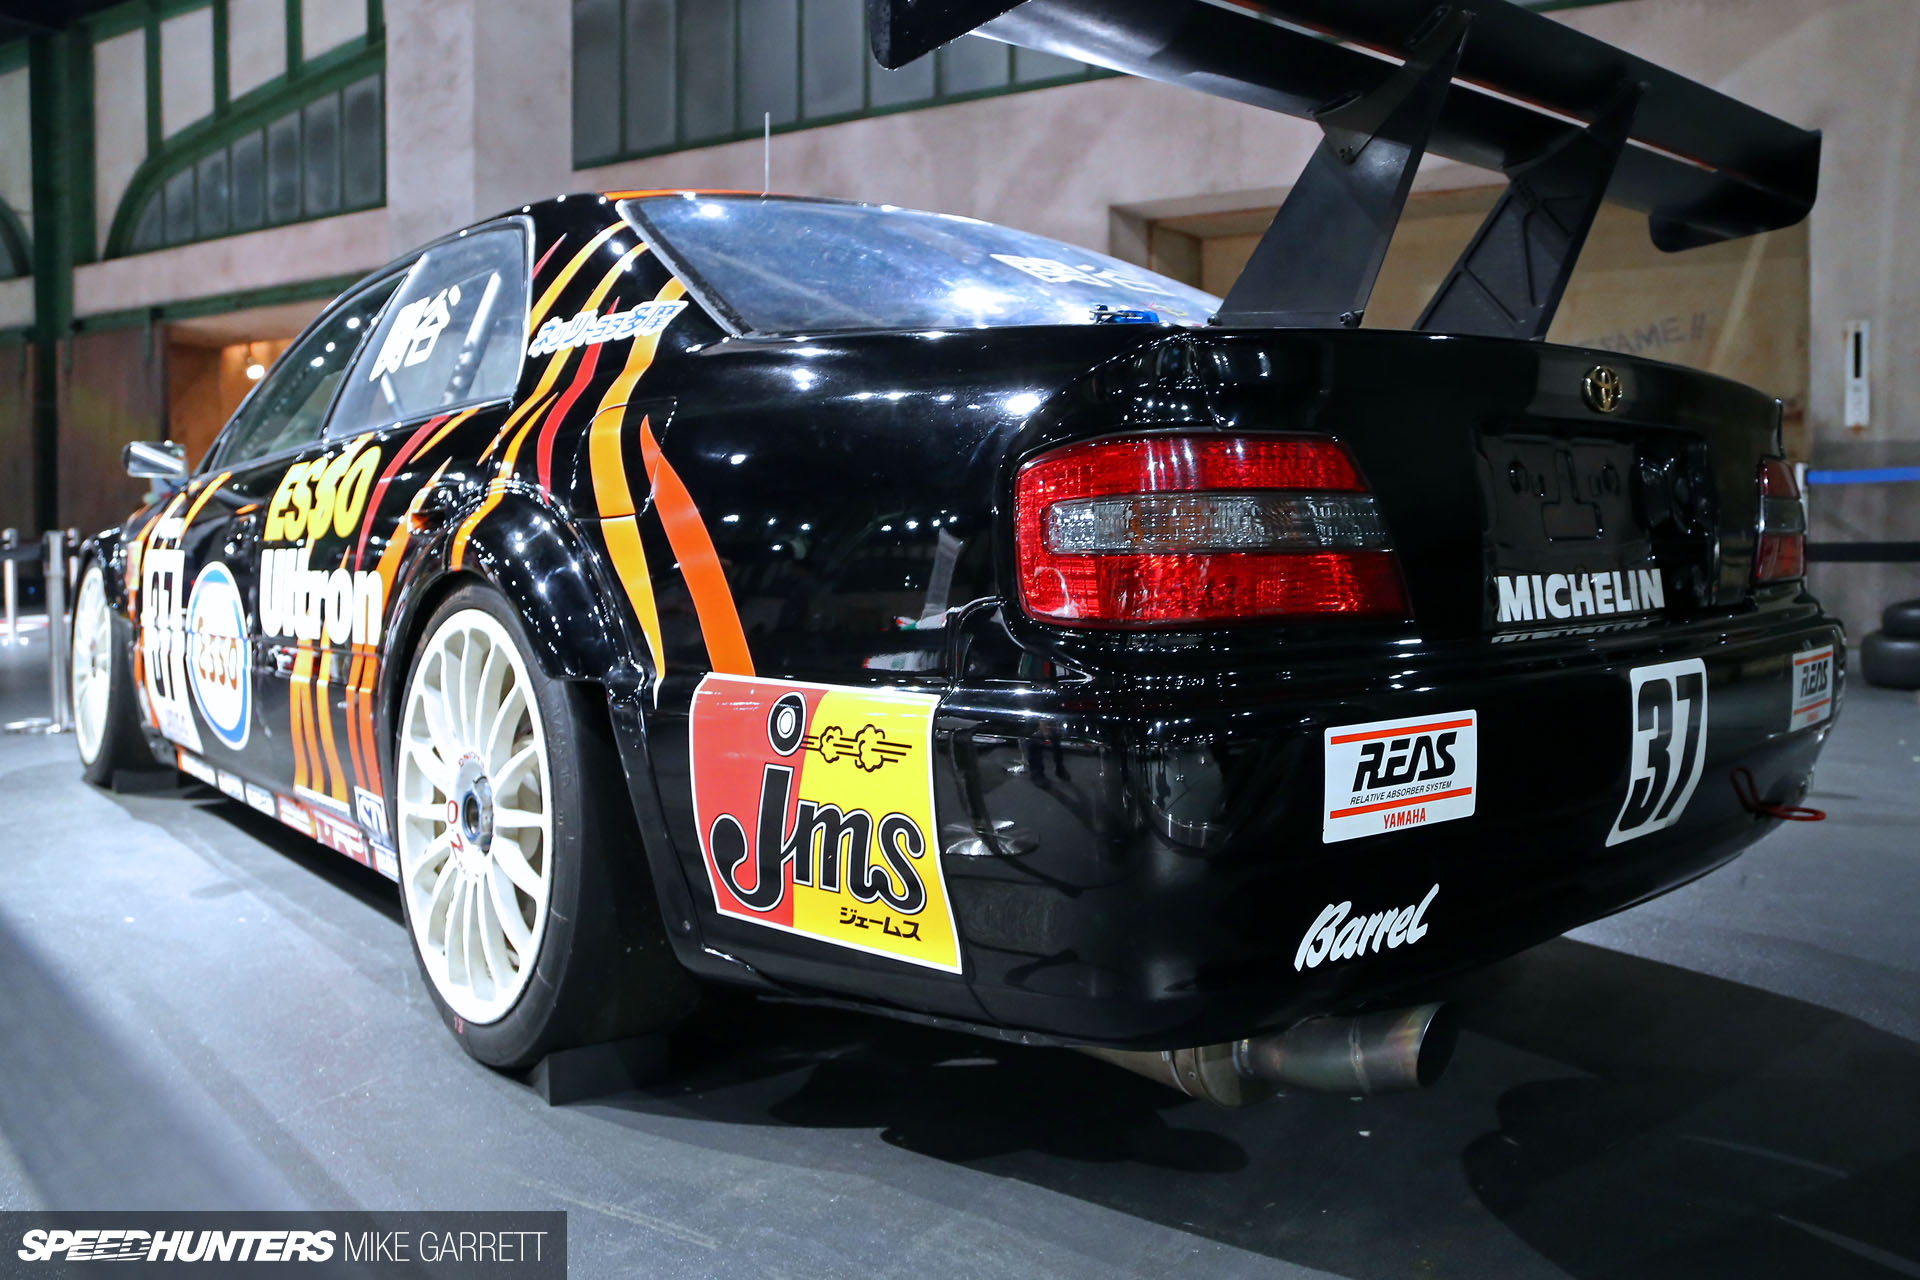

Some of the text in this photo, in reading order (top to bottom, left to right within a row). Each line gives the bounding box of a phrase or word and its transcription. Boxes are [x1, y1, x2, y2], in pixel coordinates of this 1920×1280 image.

[264, 446, 382, 541] ESSO
[259, 547, 383, 646] Ultron
[1496, 568, 1665, 623] MICHELIN
[1801, 659, 1829, 698] REAS
[1352, 731, 1457, 792] REAS
[1618, 671, 1703, 832] 37
[1350, 780, 1452, 806] RELATIVE ABSORBER SYSTEM
[1384, 807, 1426, 829] YAMAHA
[839, 907, 922, 942] ジェームス
[1294, 883, 1440, 972] Barrel
